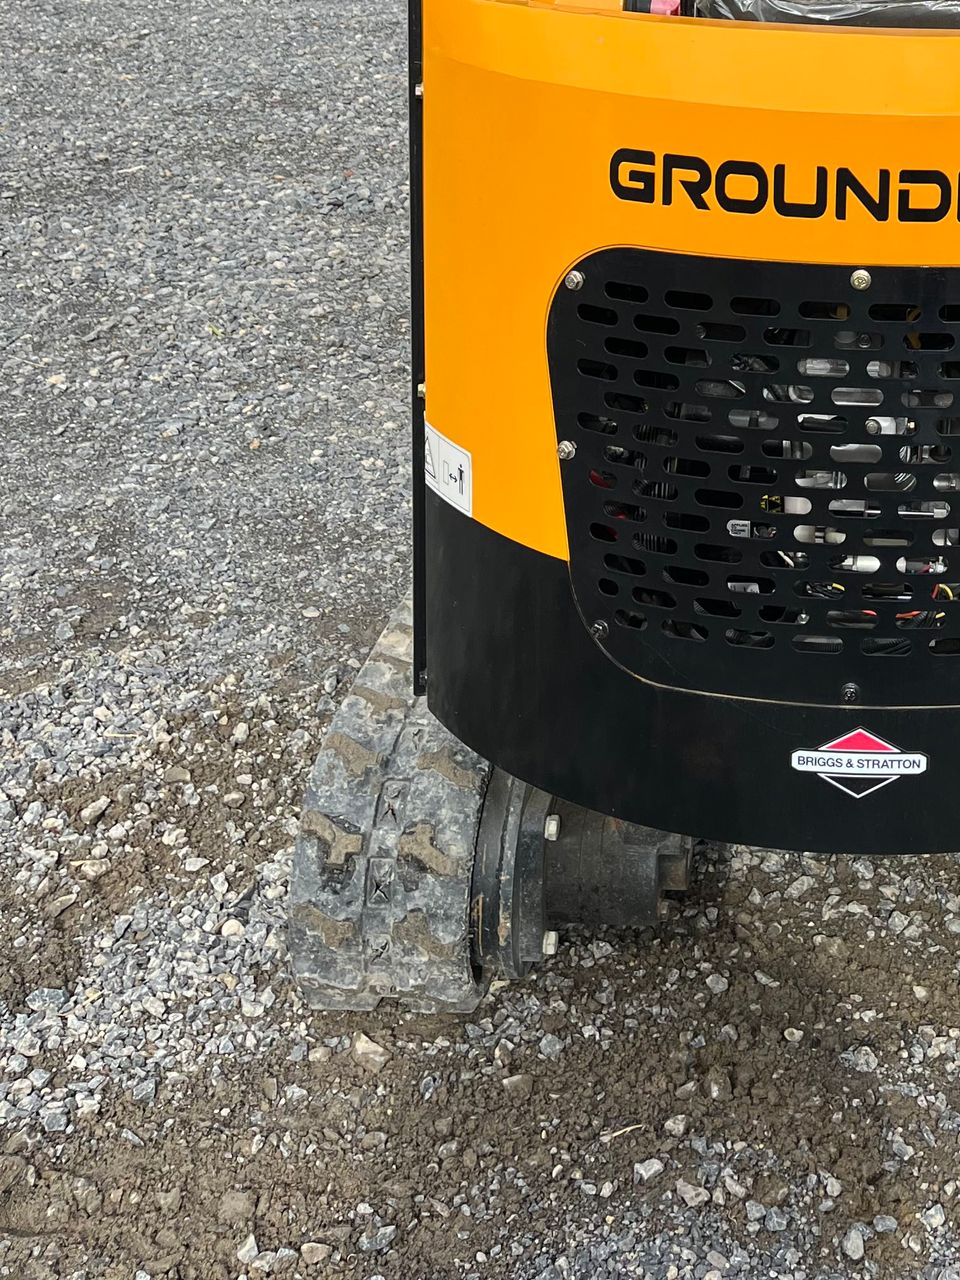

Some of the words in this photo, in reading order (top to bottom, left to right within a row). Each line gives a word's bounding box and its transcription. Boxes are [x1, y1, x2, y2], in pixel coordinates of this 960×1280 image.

[797, 755, 843, 768] BRIGGS
[845, 760, 854, 769] &
[856, 758, 920, 769] STRATTON
